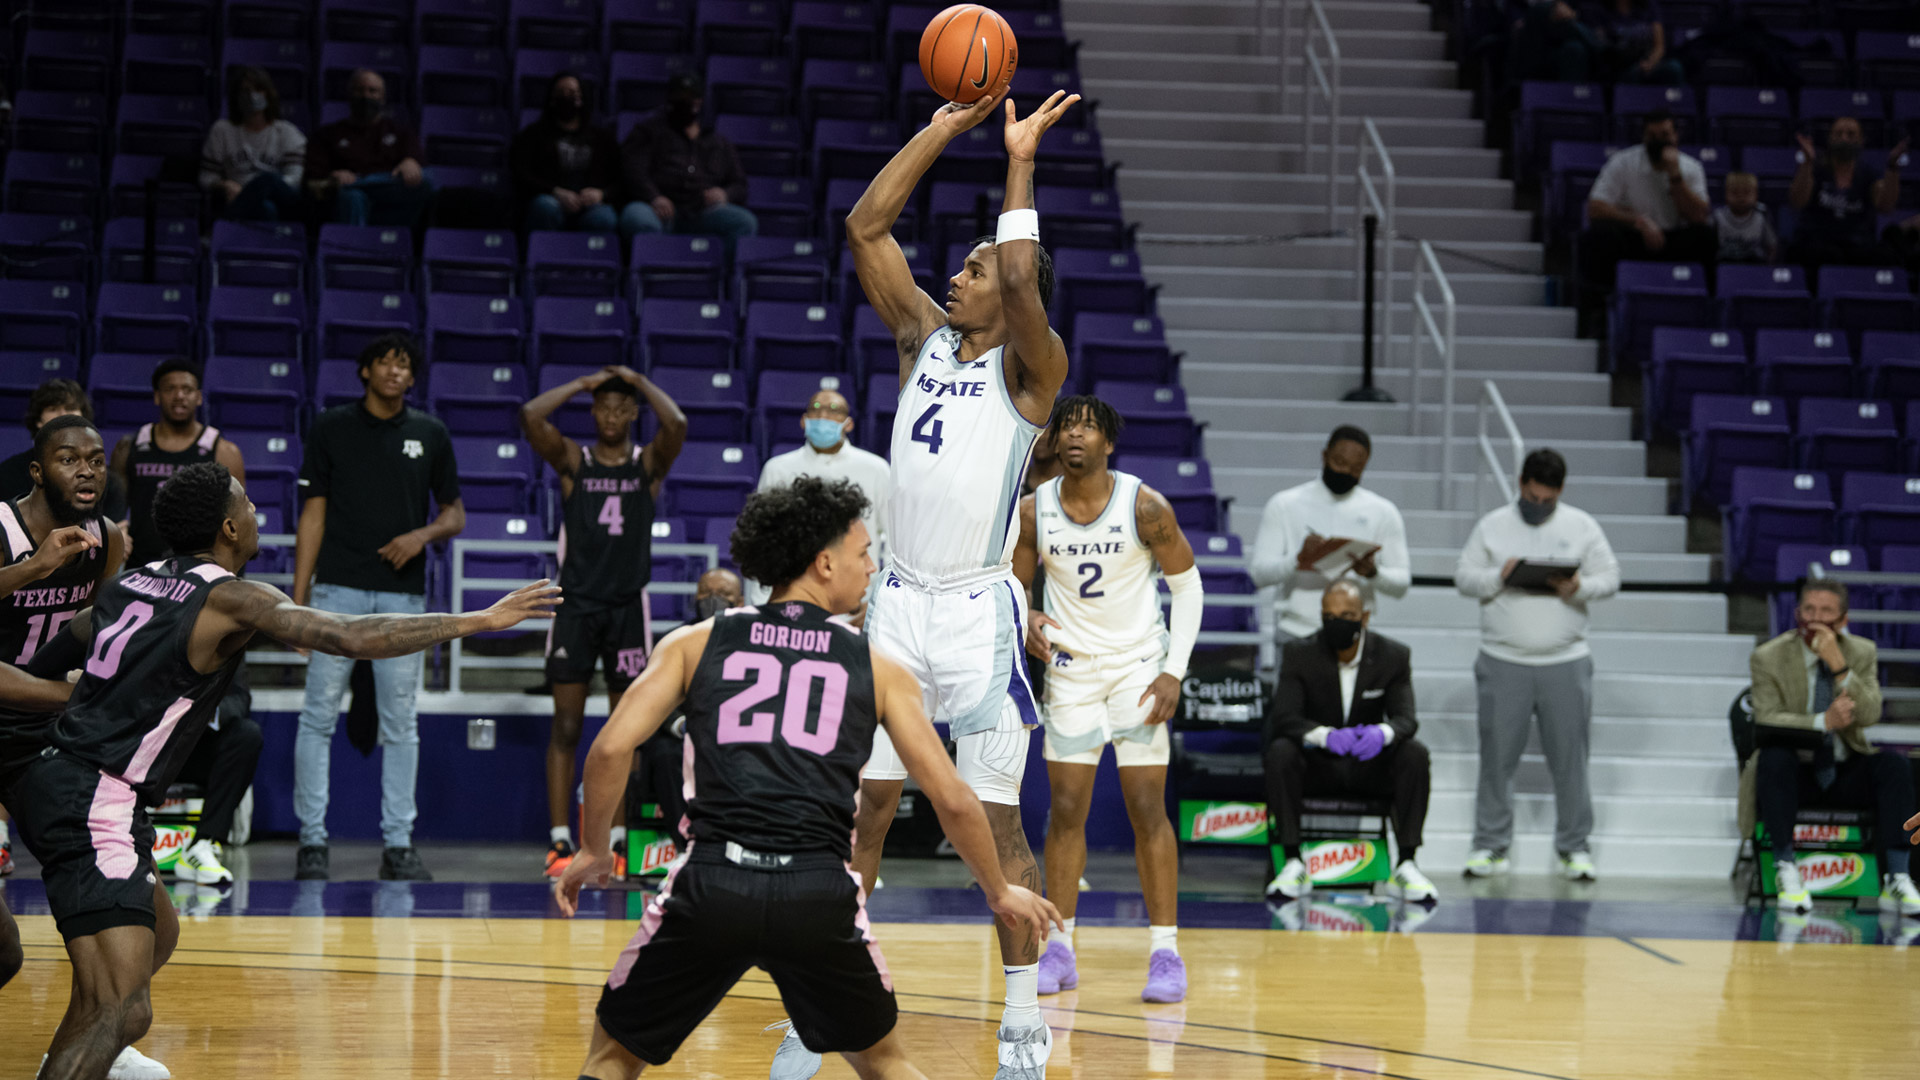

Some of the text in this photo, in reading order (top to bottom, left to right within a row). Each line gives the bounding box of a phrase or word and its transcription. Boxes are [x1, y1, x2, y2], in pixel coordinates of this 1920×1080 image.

[910, 402, 944, 455] 4
[135, 463, 174, 477] TEXAS
[582, 478, 617, 493] TEXAS
[597, 495, 625, 536] 4
[1049, 541, 1126, 556] K-STATE
[13, 580, 95, 607] TEXAS A&M
[120, 572, 177, 598] CHANDLER
[1077, 562, 1105, 599] 2
[86, 600, 154, 680] 0
[750, 621, 832, 654] GORDON
[716, 650, 849, 757] 20
[1181, 677, 1262, 702] Capitol
[1192, 809, 1267, 840] LIBMAN
[1306, 843, 1366, 876] BMAN
